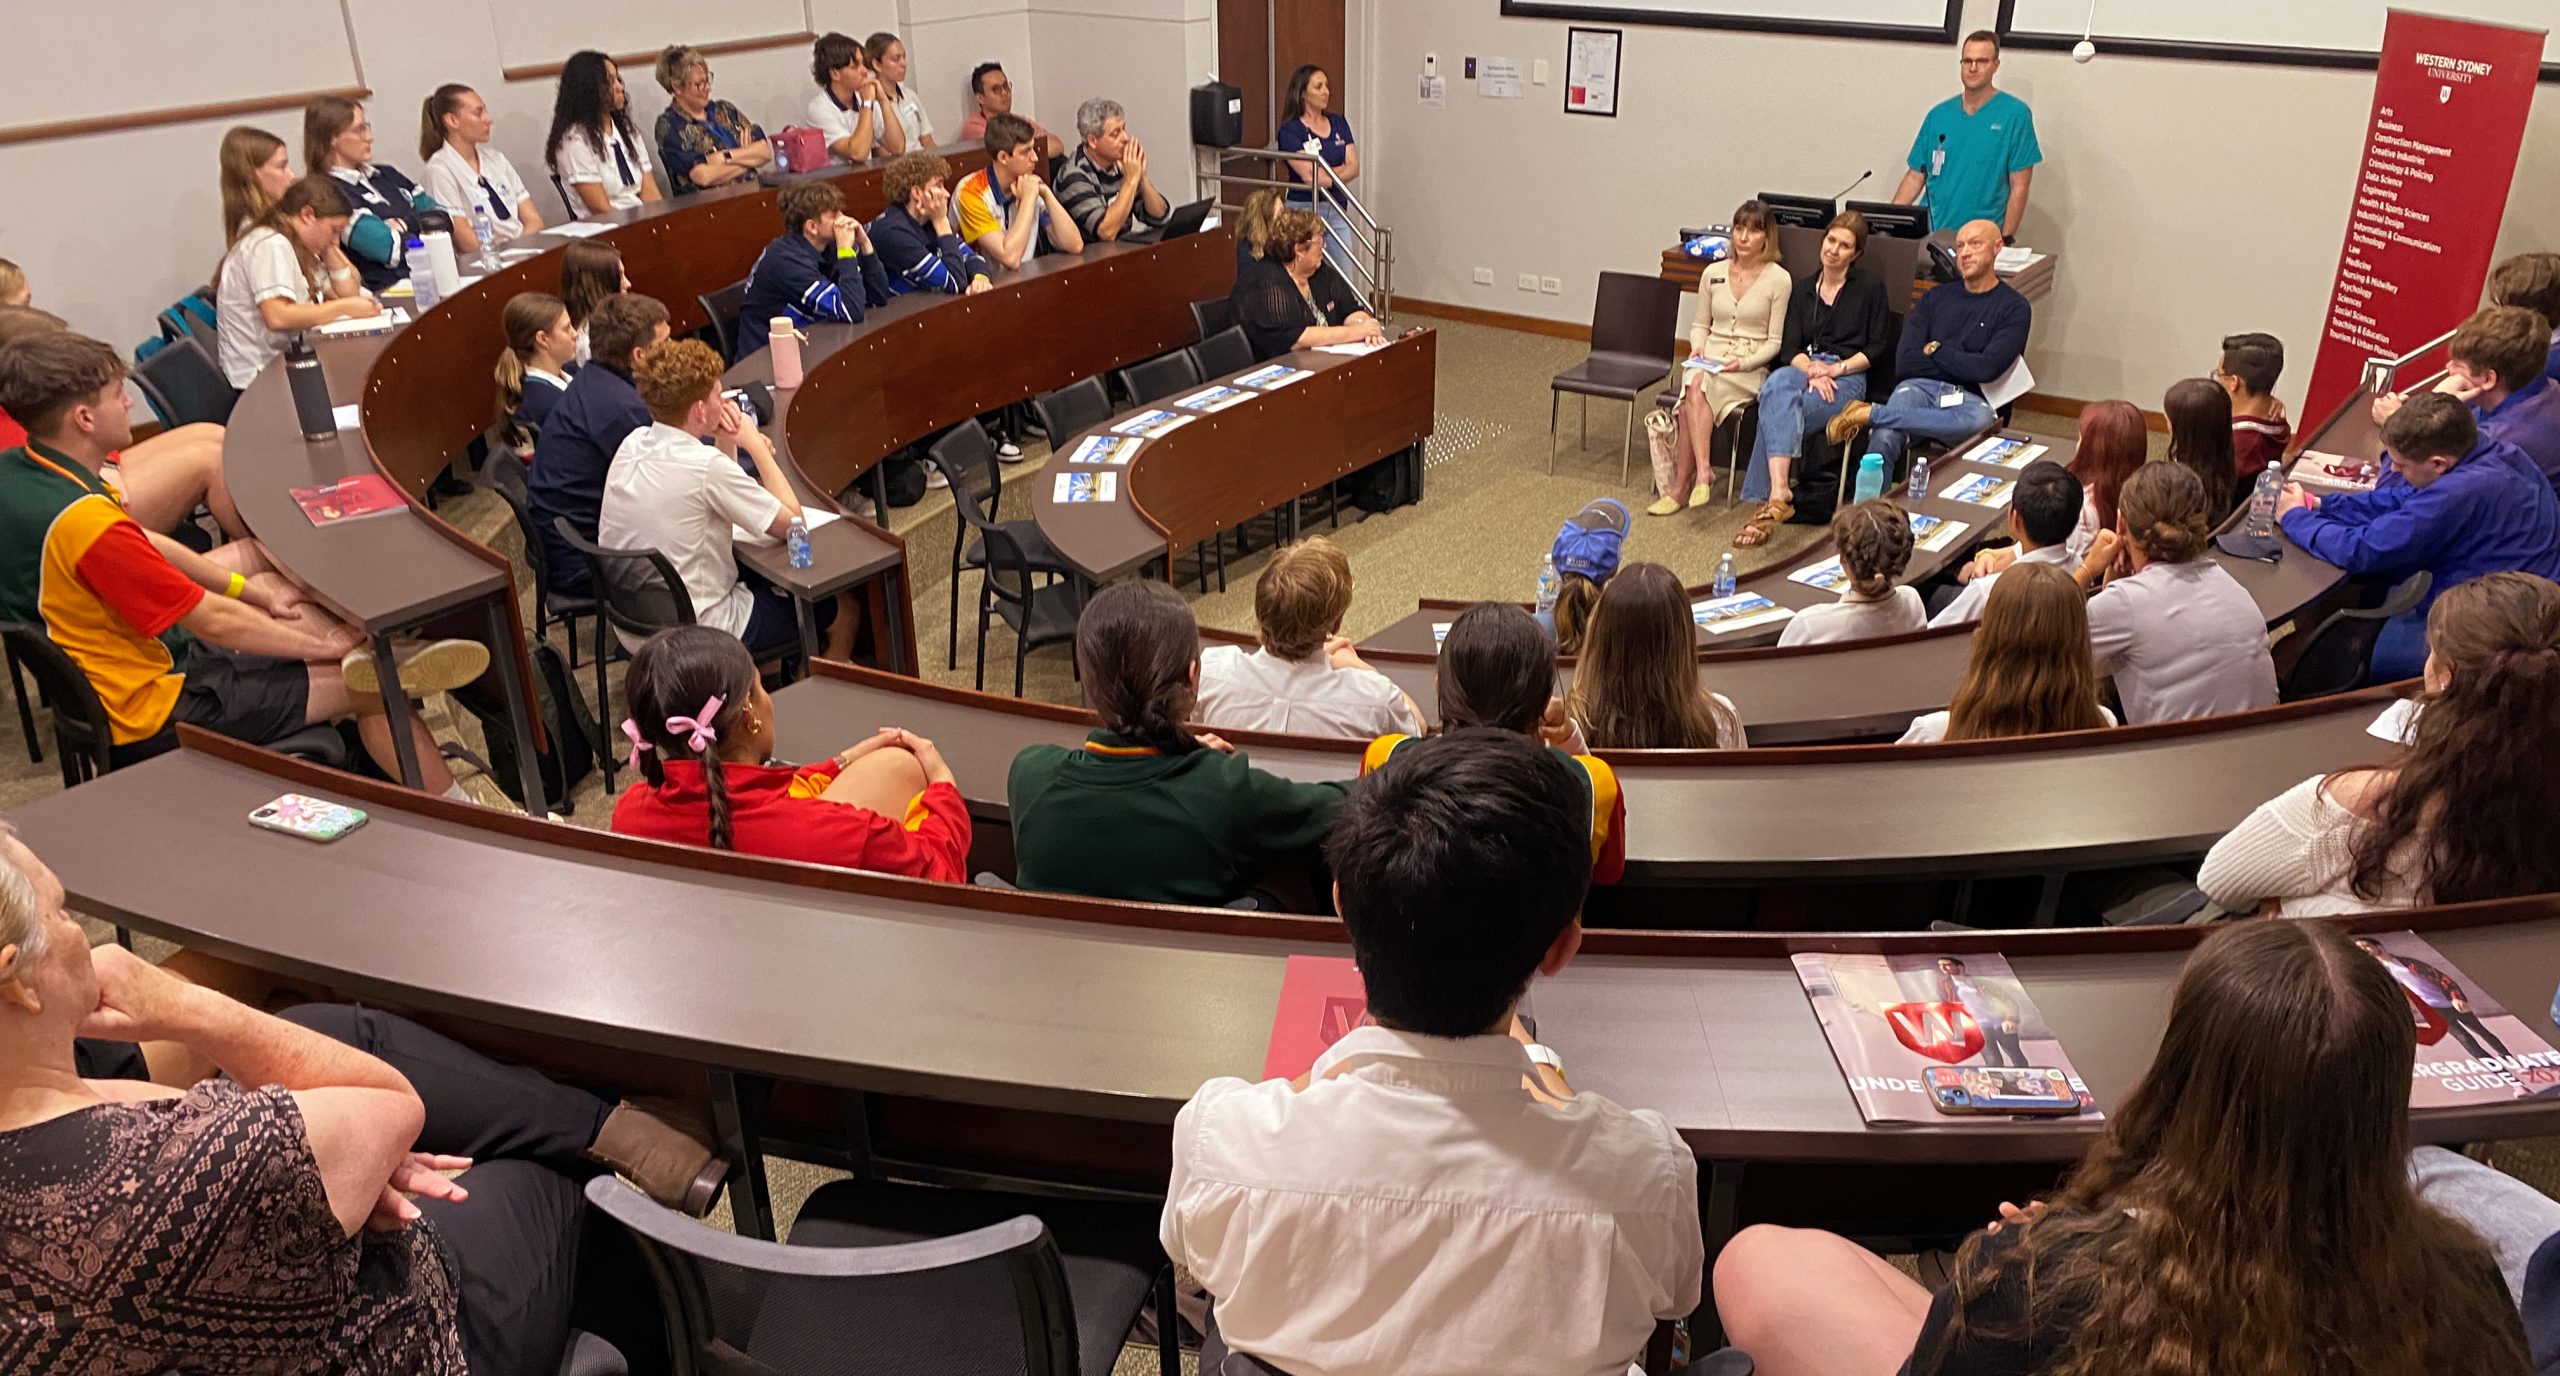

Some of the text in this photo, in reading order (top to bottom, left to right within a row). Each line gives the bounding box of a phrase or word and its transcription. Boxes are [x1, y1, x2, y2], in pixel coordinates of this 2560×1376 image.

[2416, 52, 2493, 76] WESTERN SYDNEY
[2428, 67, 2473, 84] UNIVERSITY
[2380, 106, 2394, 117] Arts
[2377, 119, 2403, 132] Business
[2375, 132, 2452, 157] Construction Management
[2371, 145, 2425, 166] Creative Industries
[2365, 171, 2403, 188] Data Science
[2369, 158, 2434, 182] Criminology & Policing
[2362, 183, 2398, 201] Engineering
[2356, 208, 2405, 229] Industrial Design
[2359, 196, 2430, 222] Health & Sports Sciences
[2353, 220, 2441, 254] Information & Communications
[2353, 231, 2386, 250] Technology
[2348, 244, 2361, 255] Law
[2345, 256, 2372, 272] Medicine
[2340, 280, 2373, 299] Psychology
[2342, 268, 2399, 295] Nursing & Midwifery
[2337, 292, 2362, 308] Sciences
[2334, 304, 2376, 326] Social Sciences
[2332, 316, 2390, 345] Teaching & Education
[2329, 327, 2399, 360] Tourism & Urban Planning
[2413, 1051, 2560, 1077] RGRADUATE
[2441, 1068, 2560, 1092] GUIDE 20
